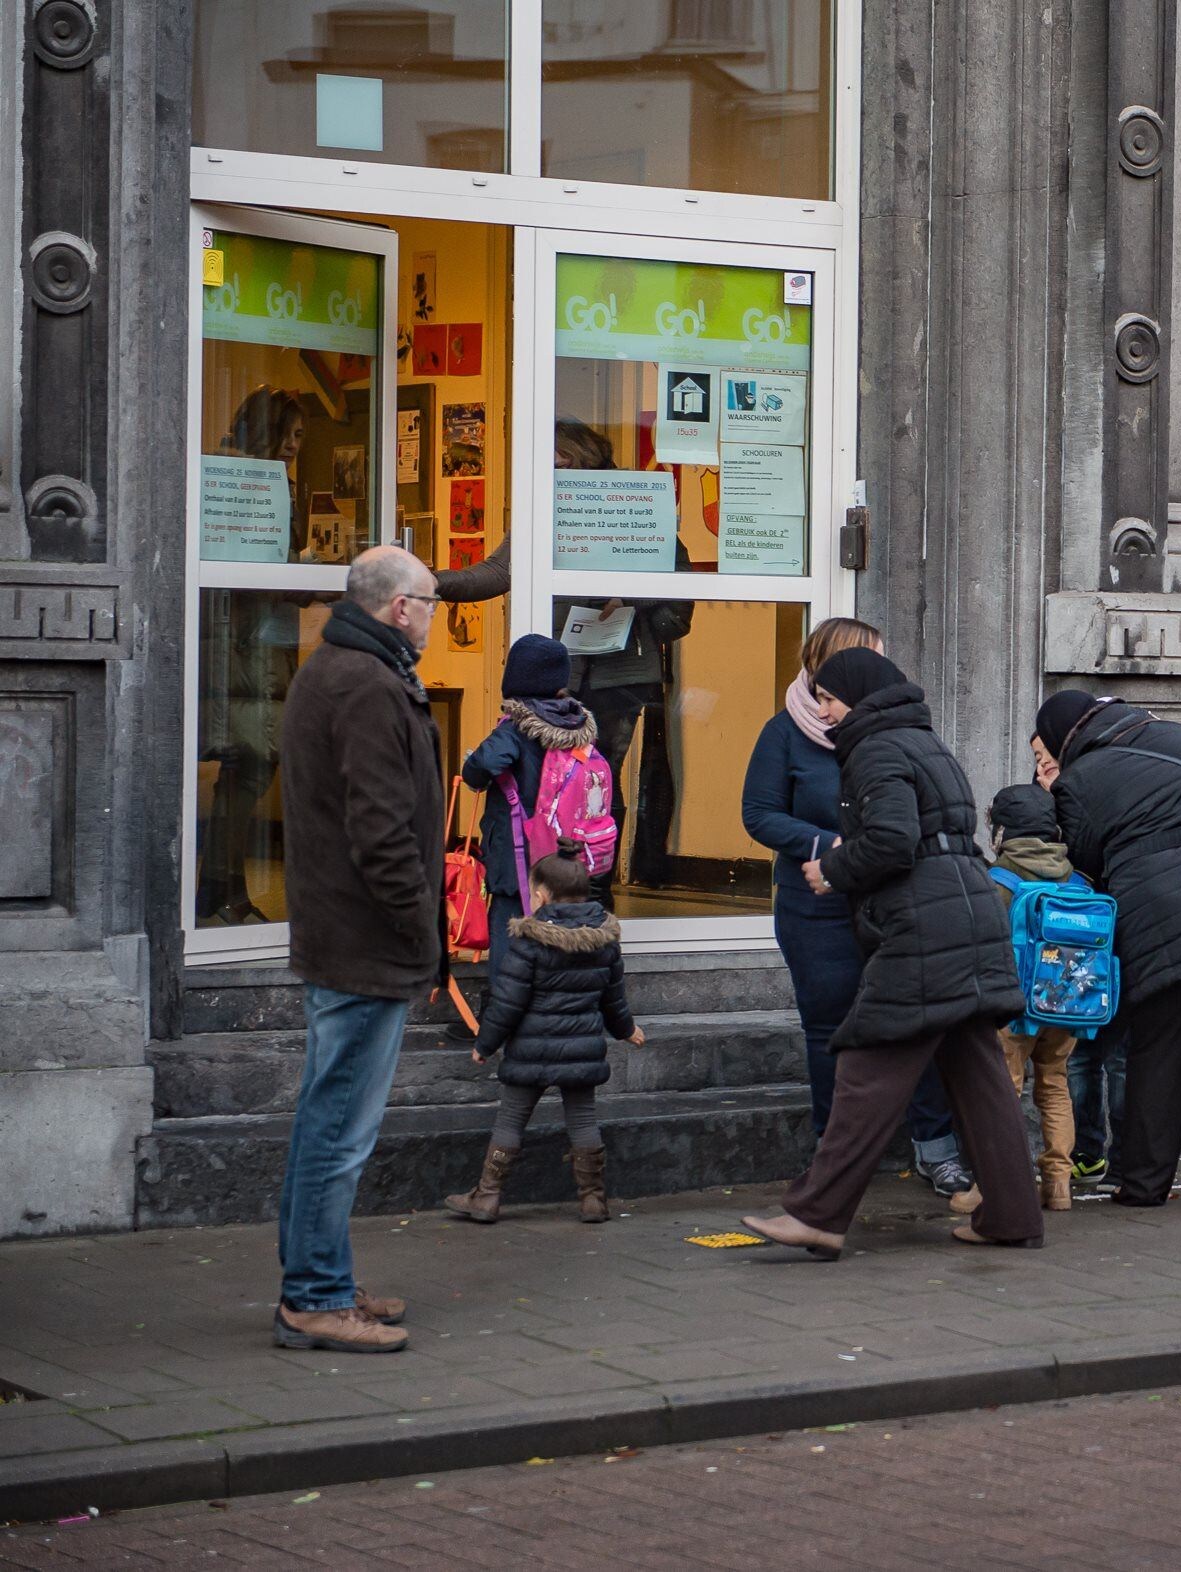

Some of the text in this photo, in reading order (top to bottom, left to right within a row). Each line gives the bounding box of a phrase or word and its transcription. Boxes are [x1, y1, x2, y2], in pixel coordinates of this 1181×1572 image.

[728, 413, 782, 423] WAARSCHUWING
[677, 428, 698, 437] 15u35
[742, 449, 783, 457] SCHOOLUREN
[557, 480, 597, 488] WOENSDAG
[611, 481, 648, 489] NOVEMBER
[557, 520, 582, 528] Afhalen
[727, 527, 755, 536] GEBRUIK
[590, 535, 614, 543] opvang
[725, 540, 737, 548] BEL
[737, 540, 747, 548] als
[756, 541, 784, 550] kinderen
